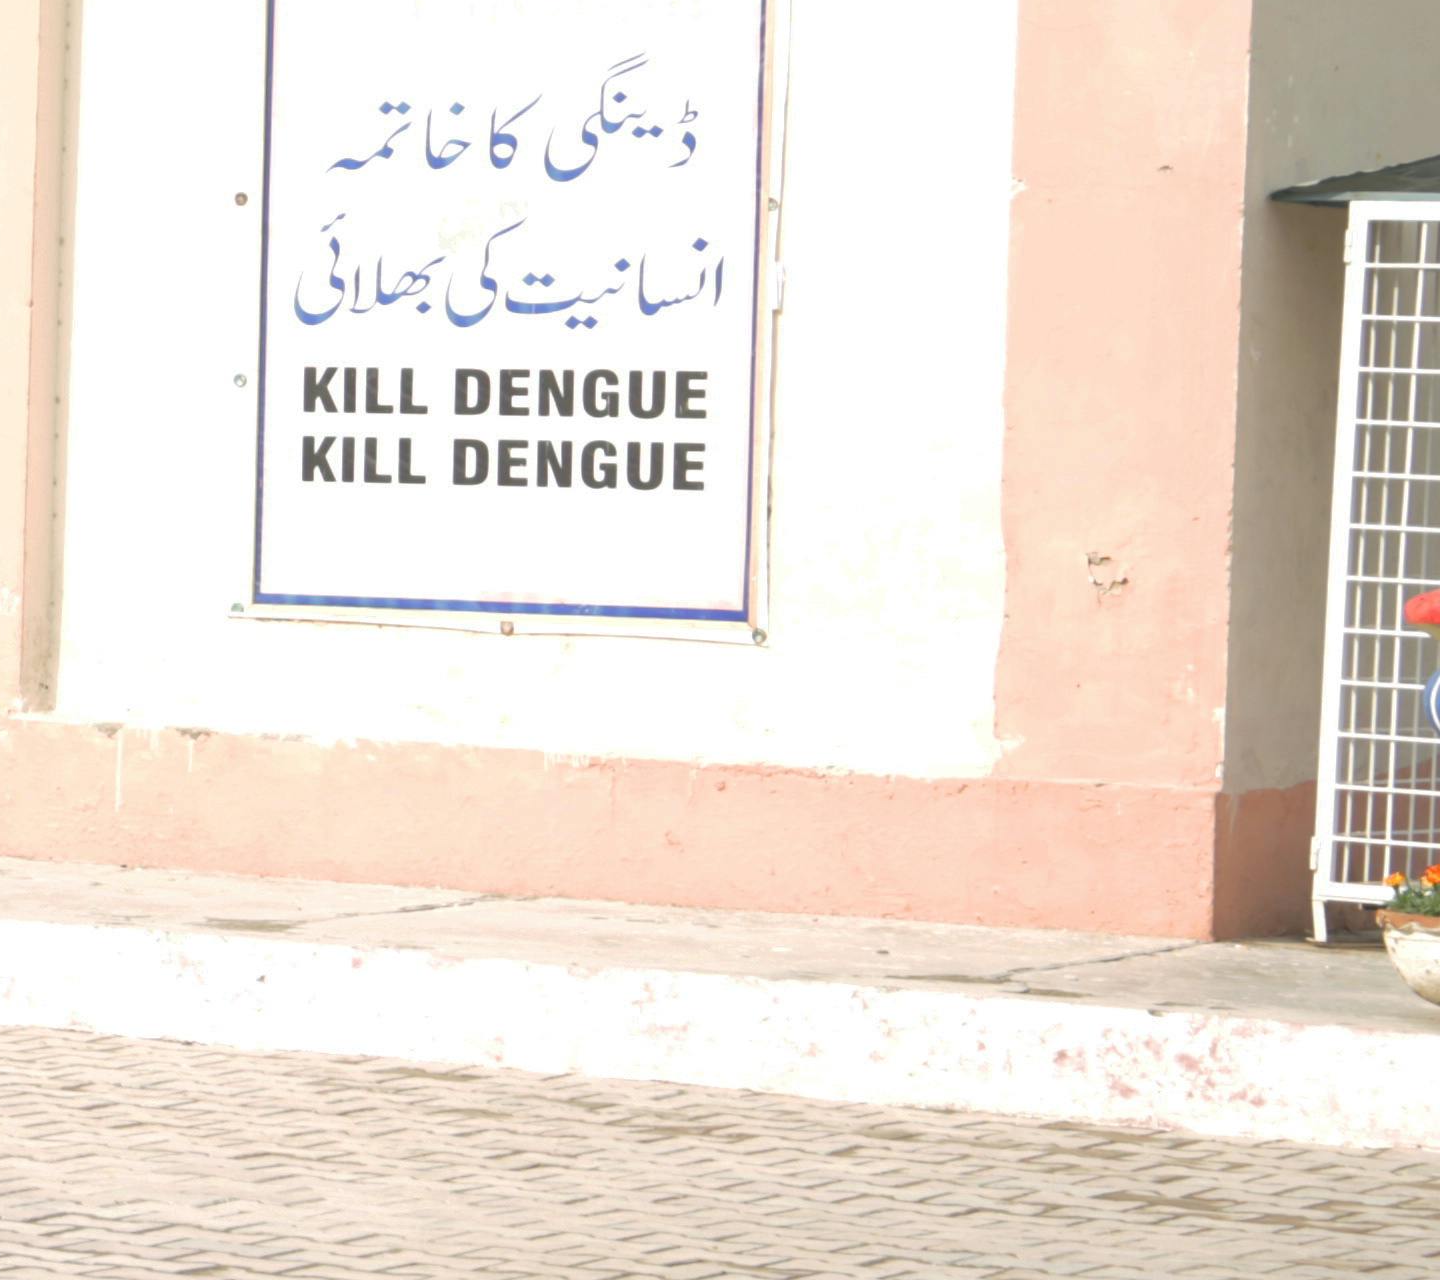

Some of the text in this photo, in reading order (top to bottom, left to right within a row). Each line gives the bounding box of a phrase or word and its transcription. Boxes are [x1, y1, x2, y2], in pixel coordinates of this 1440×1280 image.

[325, 51, 698, 183] ڈینگی کا خاتمہ
[293, 212, 725, 331] انسانیت کی بھلائی
[303, 367, 708, 419] KILL DENGUE
[301, 435, 706, 491] KILL DENGUE
